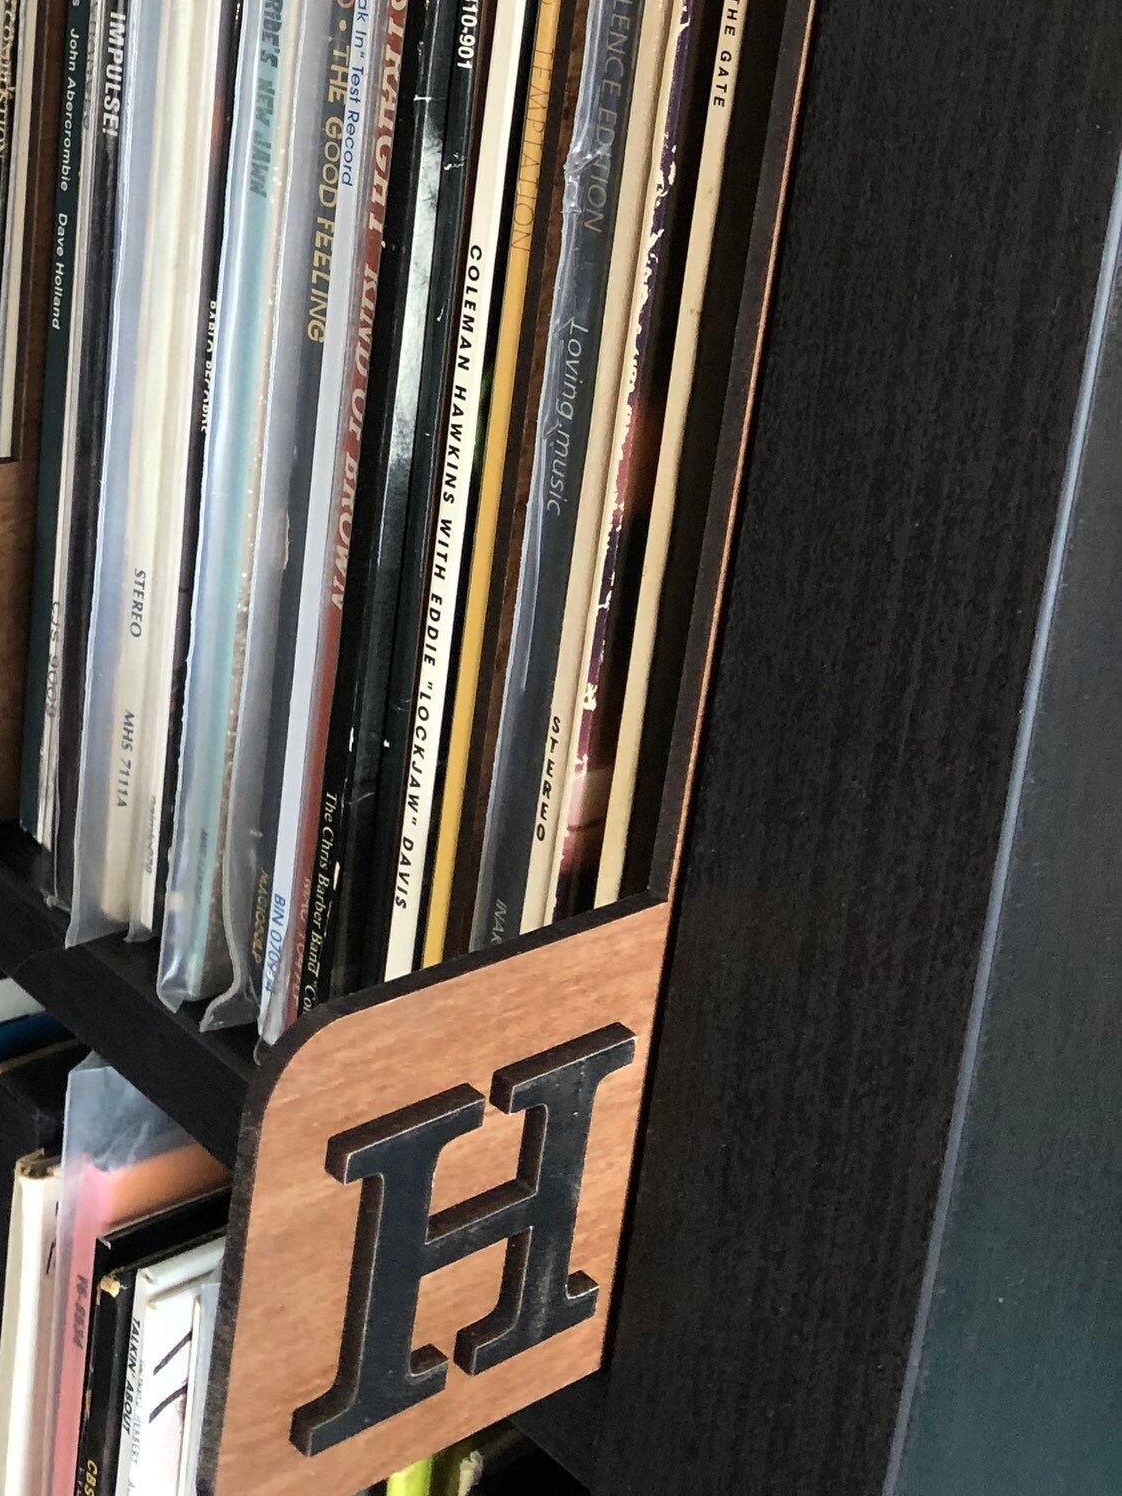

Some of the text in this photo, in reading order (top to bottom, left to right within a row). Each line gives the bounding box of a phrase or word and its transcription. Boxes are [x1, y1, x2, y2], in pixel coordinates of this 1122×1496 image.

[66, 27, 80, 72] John
[101, 10, 125, 136] IMPULSE!
[326, 42, 350, 104] THE
[347, 64, 364, 103] Test
[712, 49, 732, 108] GATE
[58, 75, 77, 192] Abercrombie
[255, 78, 275, 126] NEW
[248, 129, 271, 198] JAWN
[316, 115, 344, 208] GOOD
[339, 108, 360, 187] Record
[509, 46, 554, 254] TEMPTATION
[582, 107, 619, 233] EDITION
[54, 212, 68, 257] Dave
[49, 261, 65, 330] Holland
[305, 215, 334, 343] FEELING
[544, 318, 590, 517] Loving music
[393, 243, 483, 910] COLEMAN HAWKINS WITH EDDIE "LOCKJAW" DAVIS
[115, 567, 146, 808] STEREO MHS 7111A
[534, 715, 561, 842] STEREO
[270, 893, 286, 924] BIN
[305, 791, 338, 978] The Chris Barber Band
[290, 1021, 638, 1457] H
[125, 1317, 141, 1380] TALKIN'
[121, 1379, 135, 1435] ABOUT
[82, 1458, 98, 1496] CBS
